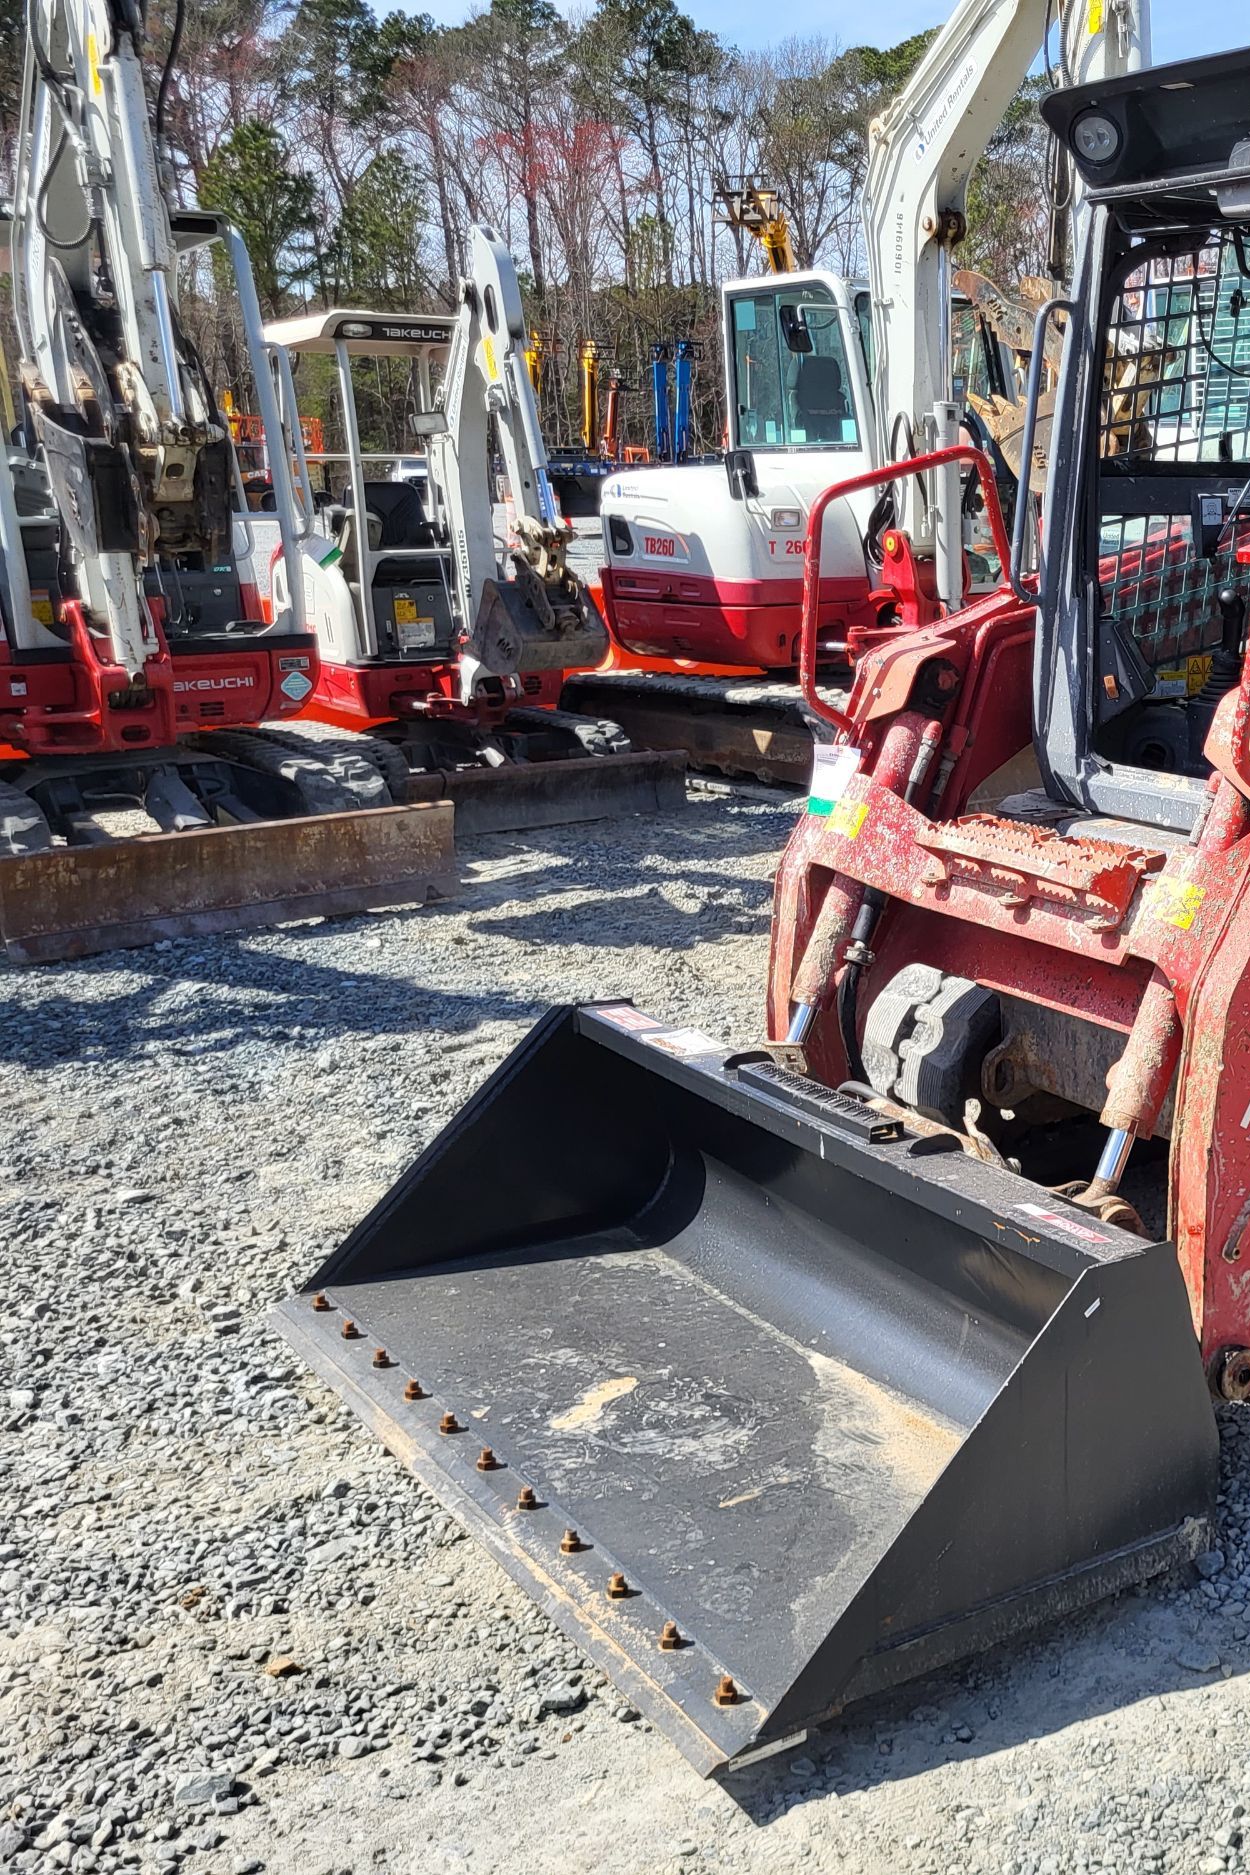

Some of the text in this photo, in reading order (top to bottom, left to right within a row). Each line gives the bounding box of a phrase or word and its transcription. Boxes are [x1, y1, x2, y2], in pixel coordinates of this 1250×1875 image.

[924, 64, 975, 145] United Rentals
[382, 327, 453, 340] TAKEUCH
[644, 536, 676, 557] TB260
[173, 676, 255, 693] AKEUCHI
